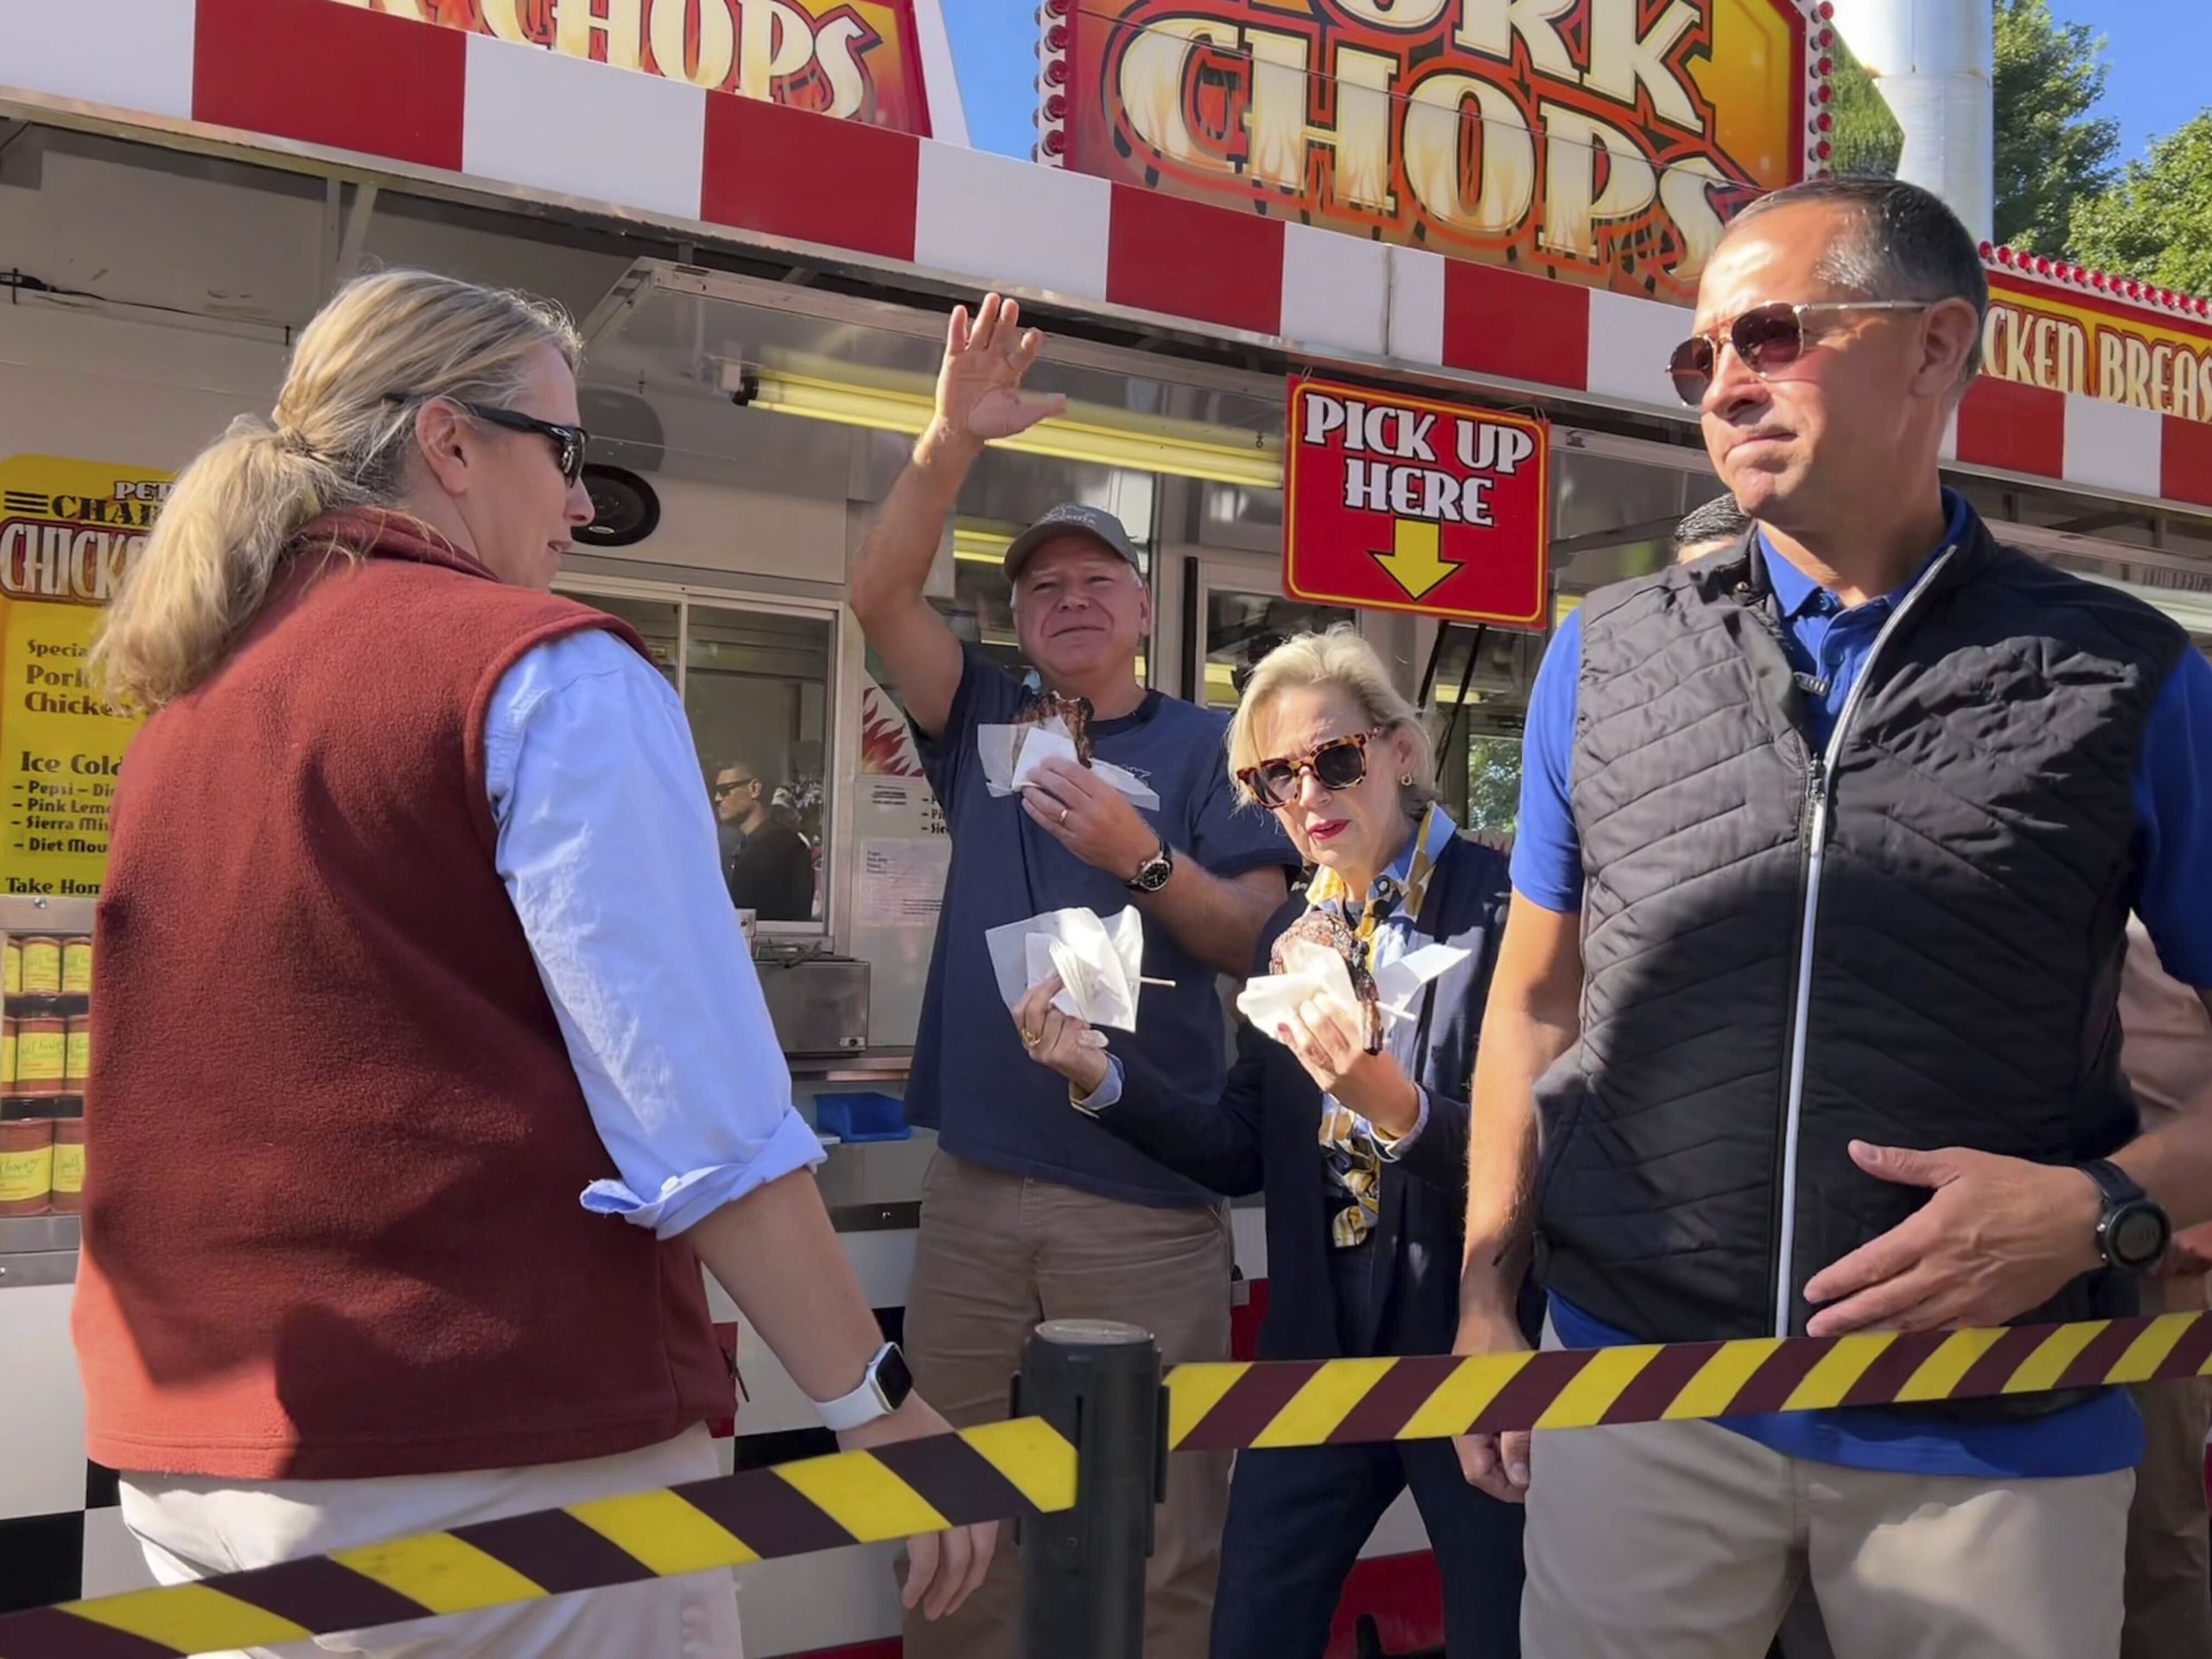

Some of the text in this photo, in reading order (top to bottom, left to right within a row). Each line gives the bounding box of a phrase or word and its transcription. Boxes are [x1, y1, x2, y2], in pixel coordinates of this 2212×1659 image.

[1118, 16, 1731, 282] CHOPS
[1303, 392, 1535, 474] PICK UP
[1344, 457, 1495, 526] HERE
[21, 751, 60, 773] Ice
[29, 780, 73, 797] Pepsi
[28, 798, 66, 812] Pink
[26, 816, 74, 830] Sierra
[29, 838, 63, 852] Diet
[5, 877, 54, 893] Take
